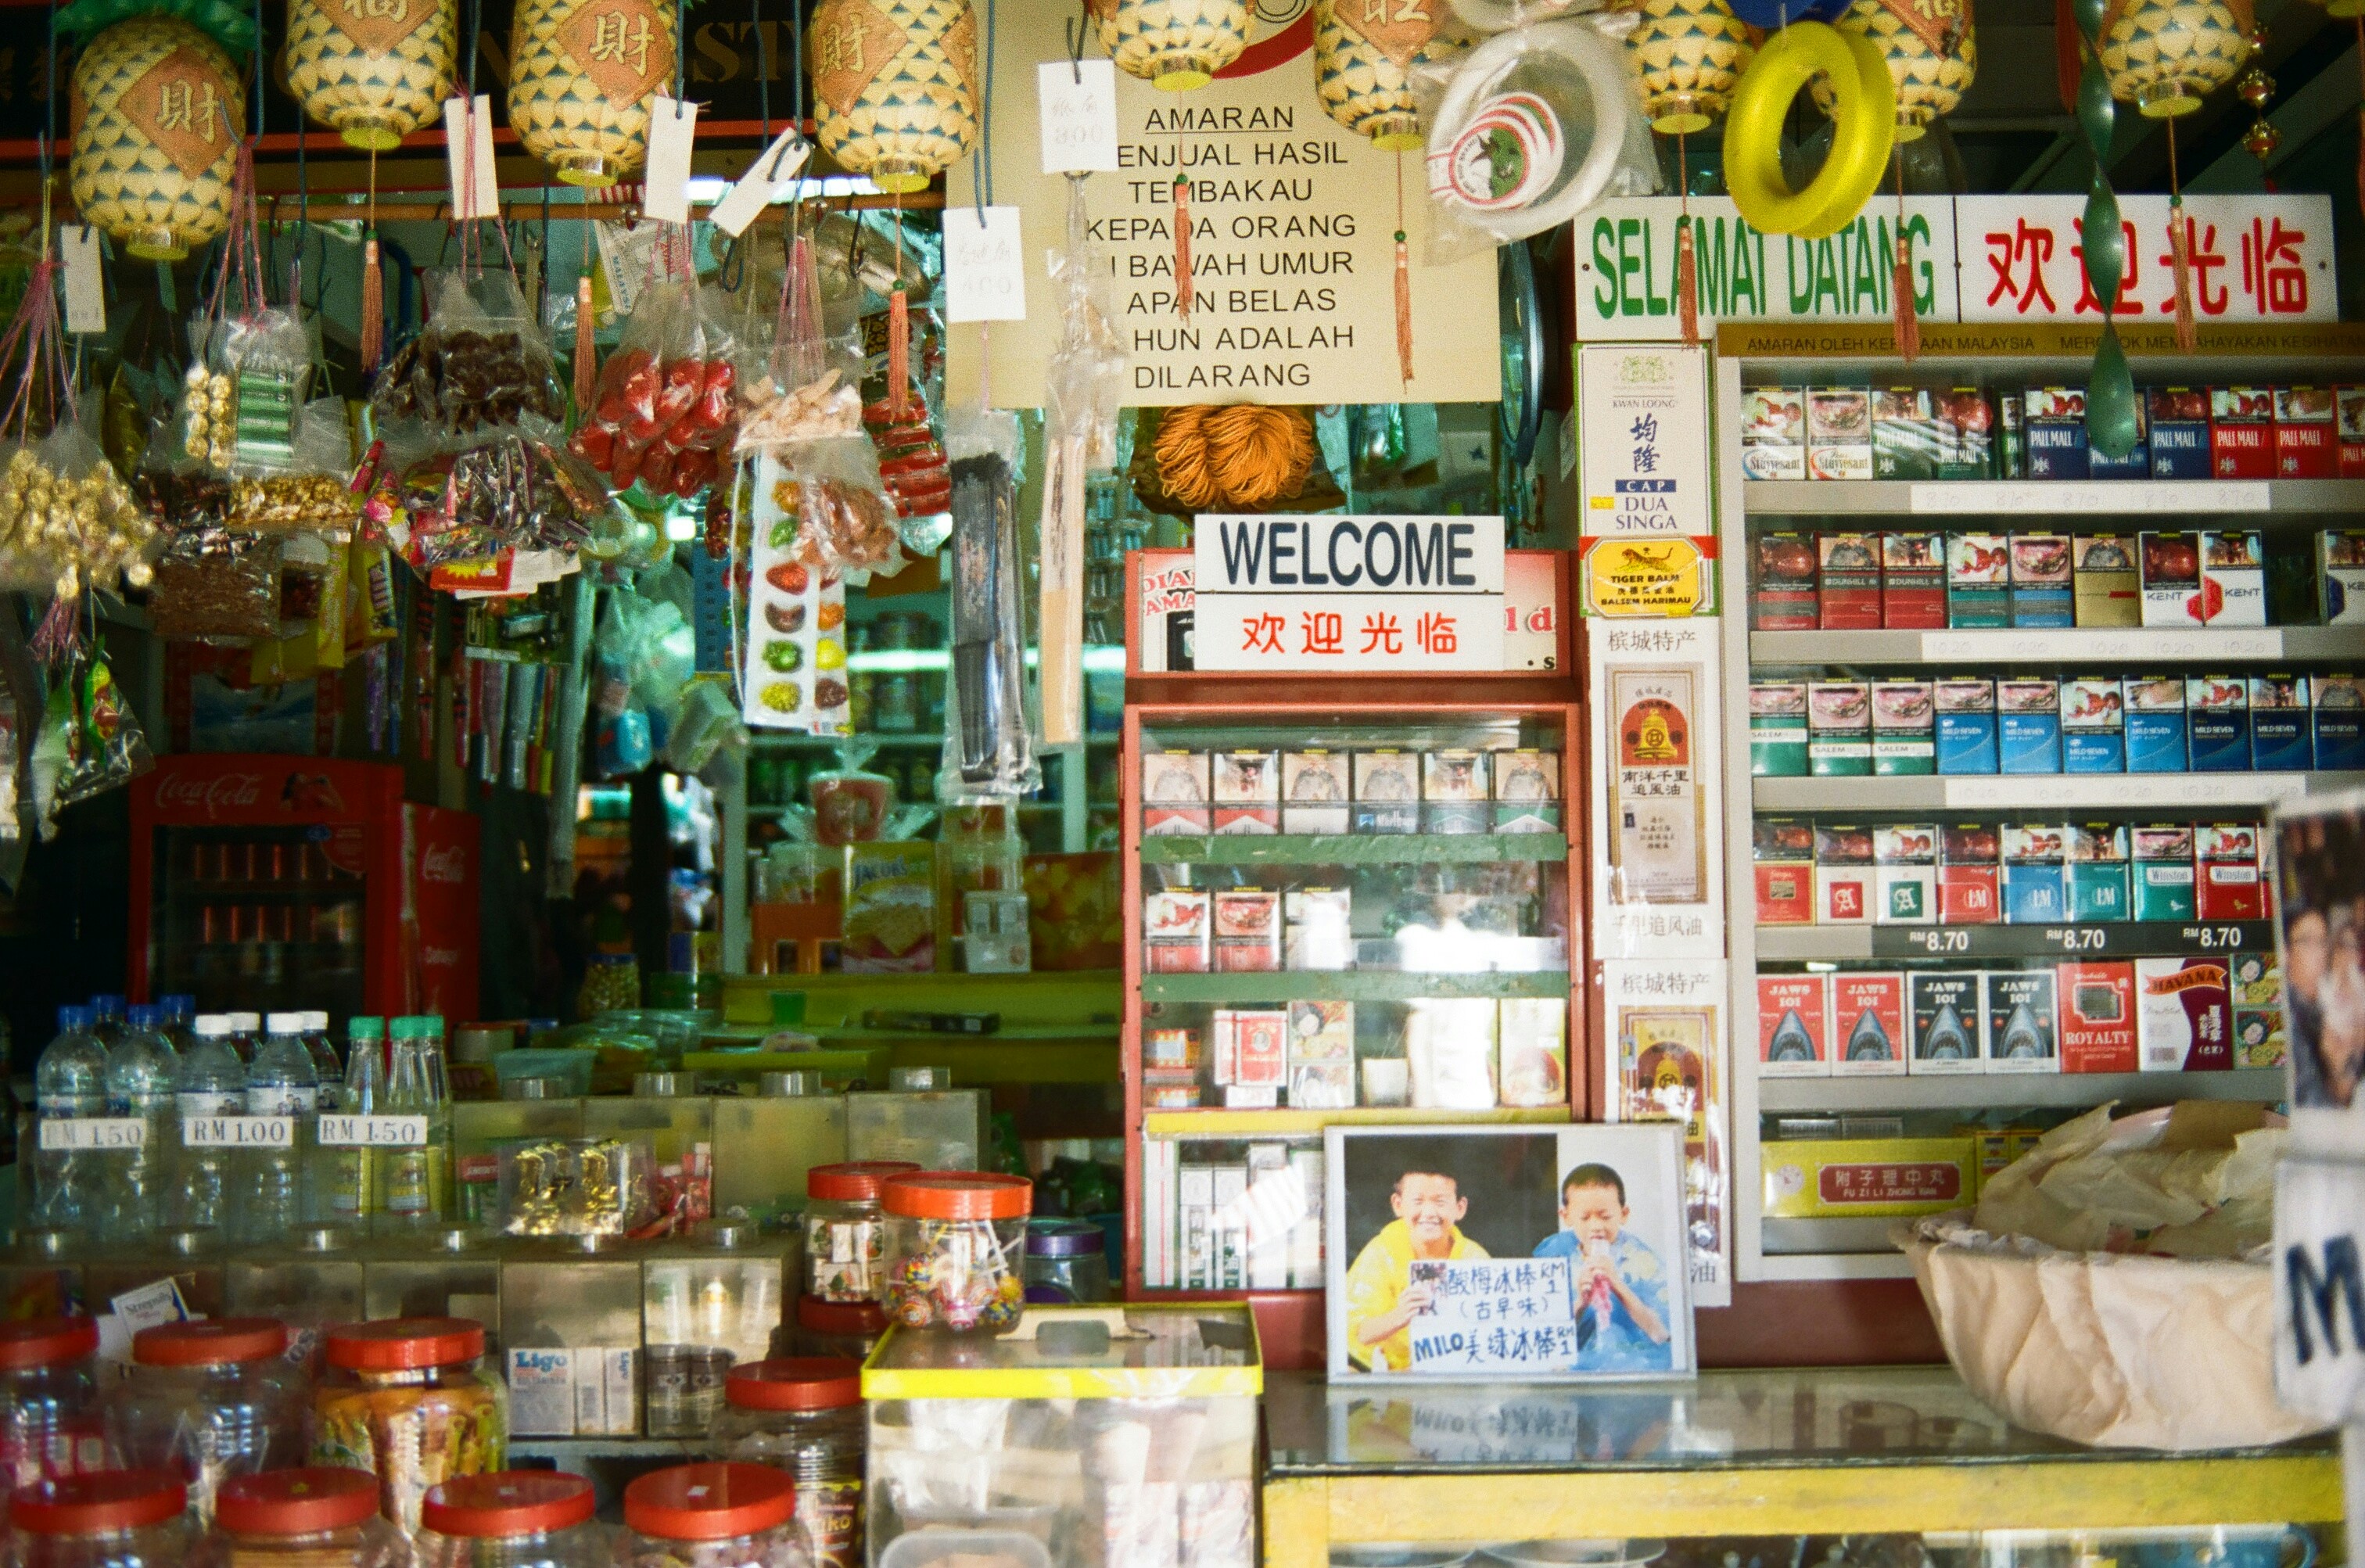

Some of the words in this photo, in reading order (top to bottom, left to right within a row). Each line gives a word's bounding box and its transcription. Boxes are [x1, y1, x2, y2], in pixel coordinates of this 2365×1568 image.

[1145, 106, 1293, 131] AMARAN
[1117, 144, 1241, 167] ENJUAL
[1255, 142, 1348, 165] HASIL
[1087, 217, 1217, 241] KEPAA
[1232, 213, 1356, 239] ORANG
[1260, 251, 1354, 275] UMUR
[1127, 290, 1215, 314] APAN
[1229, 288, 1337, 313] BELAS
[1134, 328, 1200, 351] HUN
[1215, 325, 1353, 350] ADALAH
[1135, 363, 1311, 389] DILARANG
[1626, 480, 1666, 492] CAP
[1624, 497, 1668, 512] DUA
[1616, 514, 1678, 529] SINGA
[1219, 520, 1476, 587] WELCOME
[1610, 575, 1645, 583] TIGER
[1642, 596, 1691, 605] HARIMAU
[2147, 591, 2183, 601] KENT
[2224, 588, 2260, 597] KENT
[1240, 610, 1459, 655] 欢迎光临
[2215, 867, 2252, 880] Winston
[1910, 932, 1926, 942] RM
[1926, 931, 1968, 951] 8.70
[2046, 930, 2062, 940] RM
[2064, 929, 2105, 949] 8.70
[2183, 928, 2199, 938] RM
[2200, 927, 2242, 947] 8.70
[1768, 985, 1811, 995] JAWS
[1846, 984, 1888, 995] JAWS
[1925, 981, 1966, 992] JAWS
[2000, 981, 2040, 992] JAWS
[2151, 968, 2216, 992] HAVANA
[2065, 1032, 2129, 1045] ROYALTY
[195, 1119, 226, 1140] RM
[236, 1121, 285, 1142] 1.00
[323, 1118, 353, 1140] RM
[366, 1121, 416, 1143] 1.50
